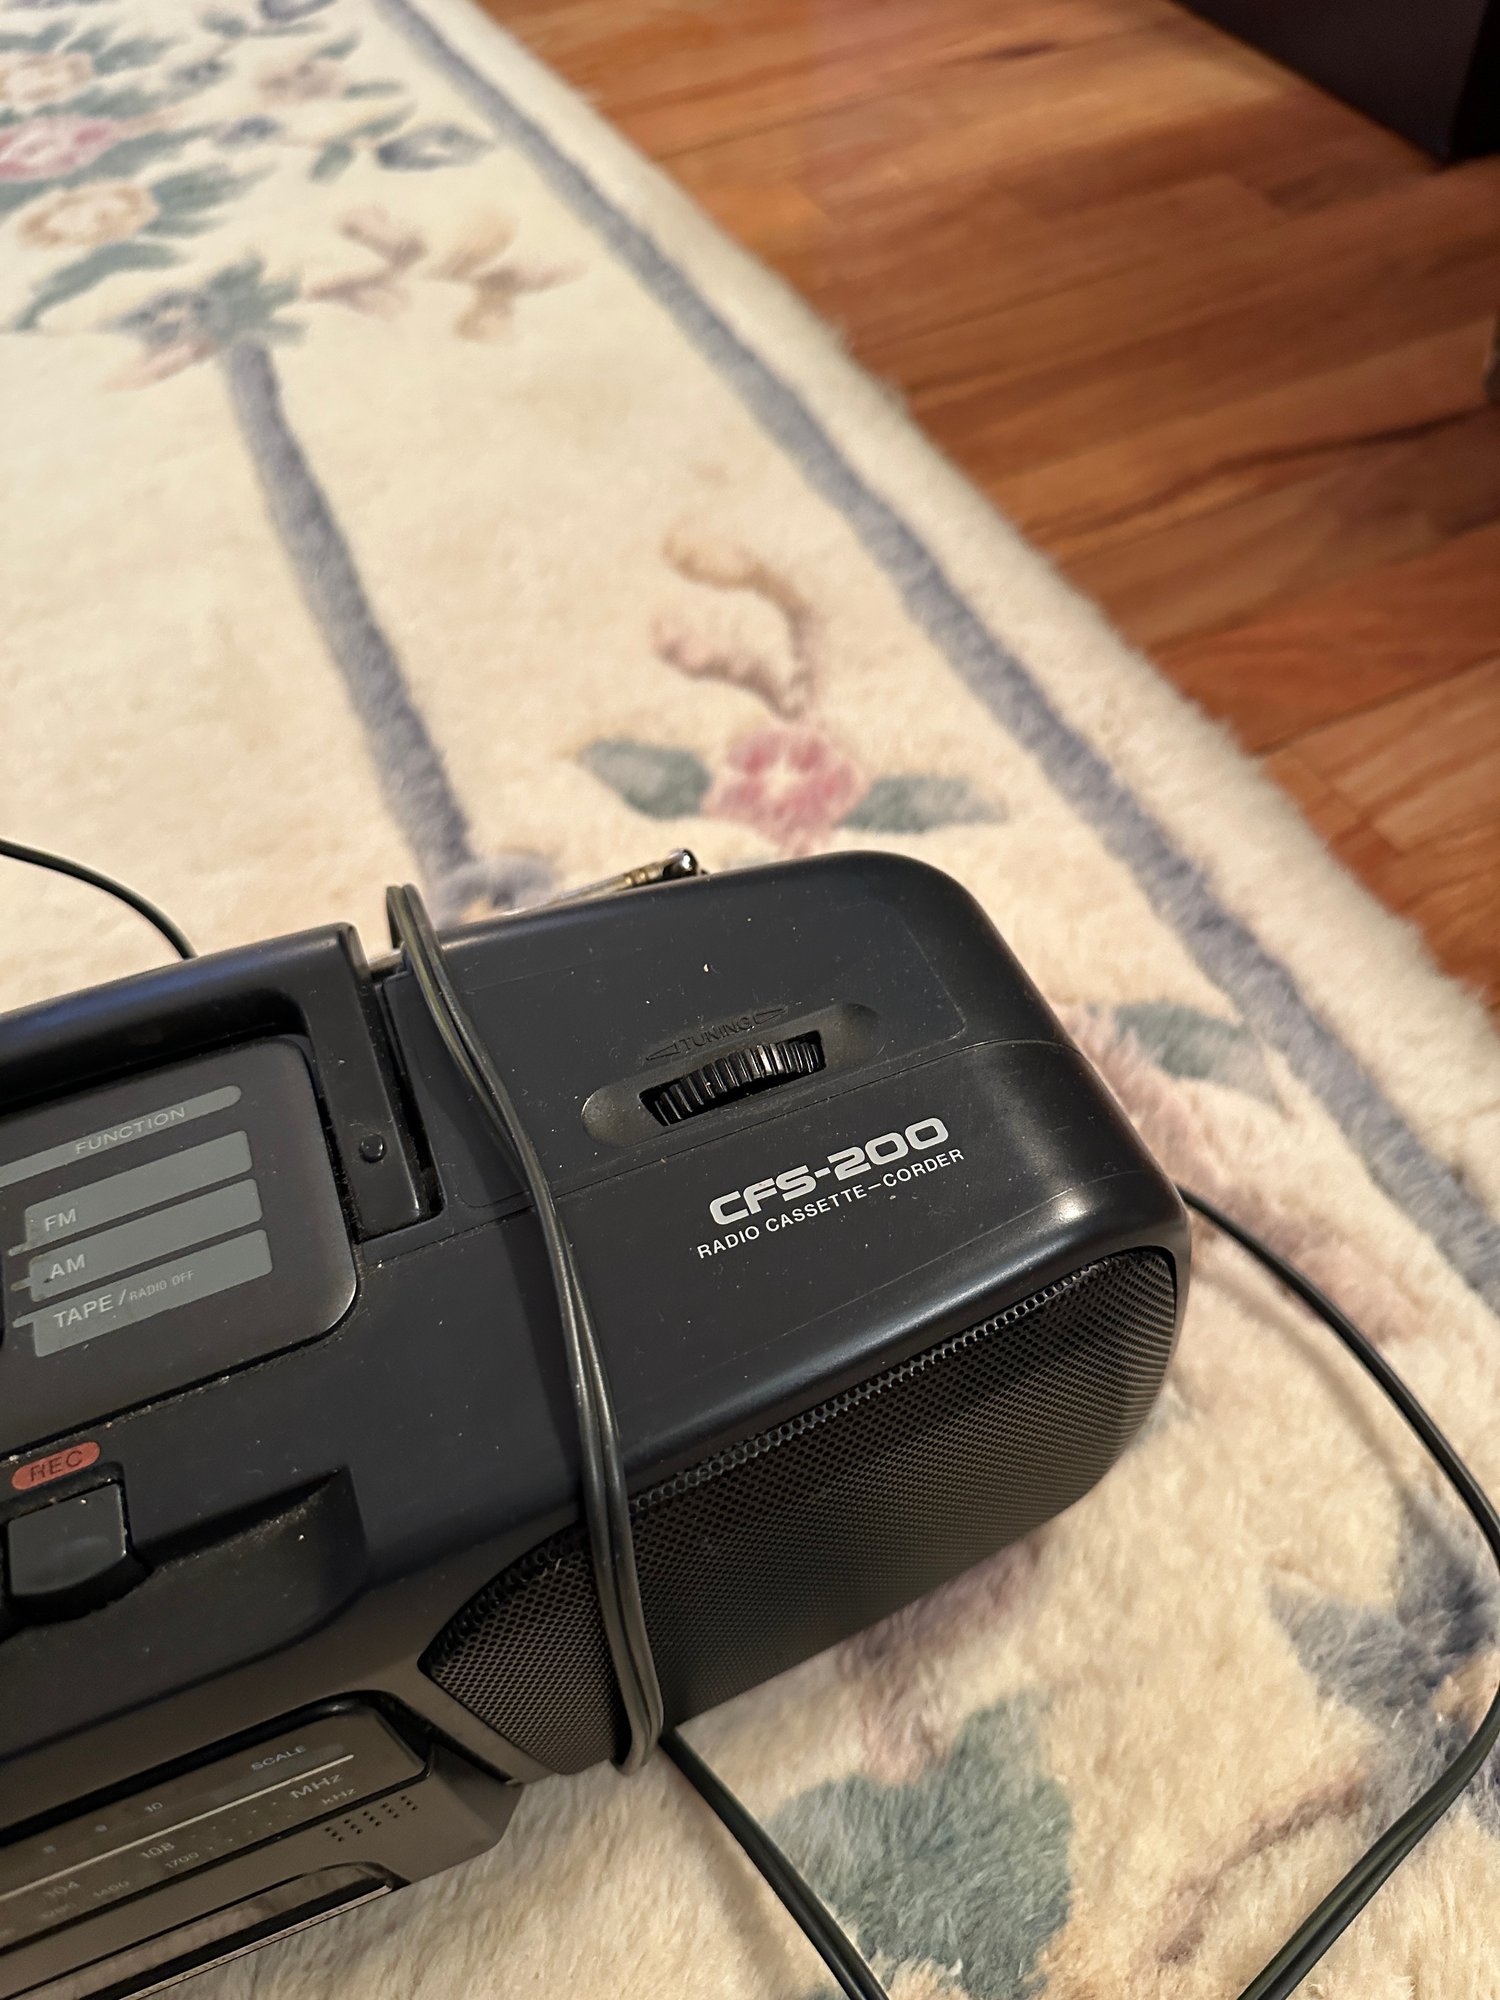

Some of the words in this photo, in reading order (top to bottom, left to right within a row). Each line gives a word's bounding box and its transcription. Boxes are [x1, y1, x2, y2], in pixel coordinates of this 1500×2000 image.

[678, 1014, 752, 1053] TUNING
[75, 1106, 186, 1155] FUNCTION
[709, 1117, 949, 1226] CFS-200
[44, 1208, 77, 1232] FM
[697, 1224, 760, 1259] RADIO
[49, 1254, 86, 1280] AM
[172, 1269, 196, 1288] OFF
[30, 1449, 84, 1482] REC
[250, 1744, 308, 1771] SCALE
[288, 1772, 345, 1800] MHz
[320, 1786, 358, 1806] kHz
[144, 1801, 163, 1813] 10
